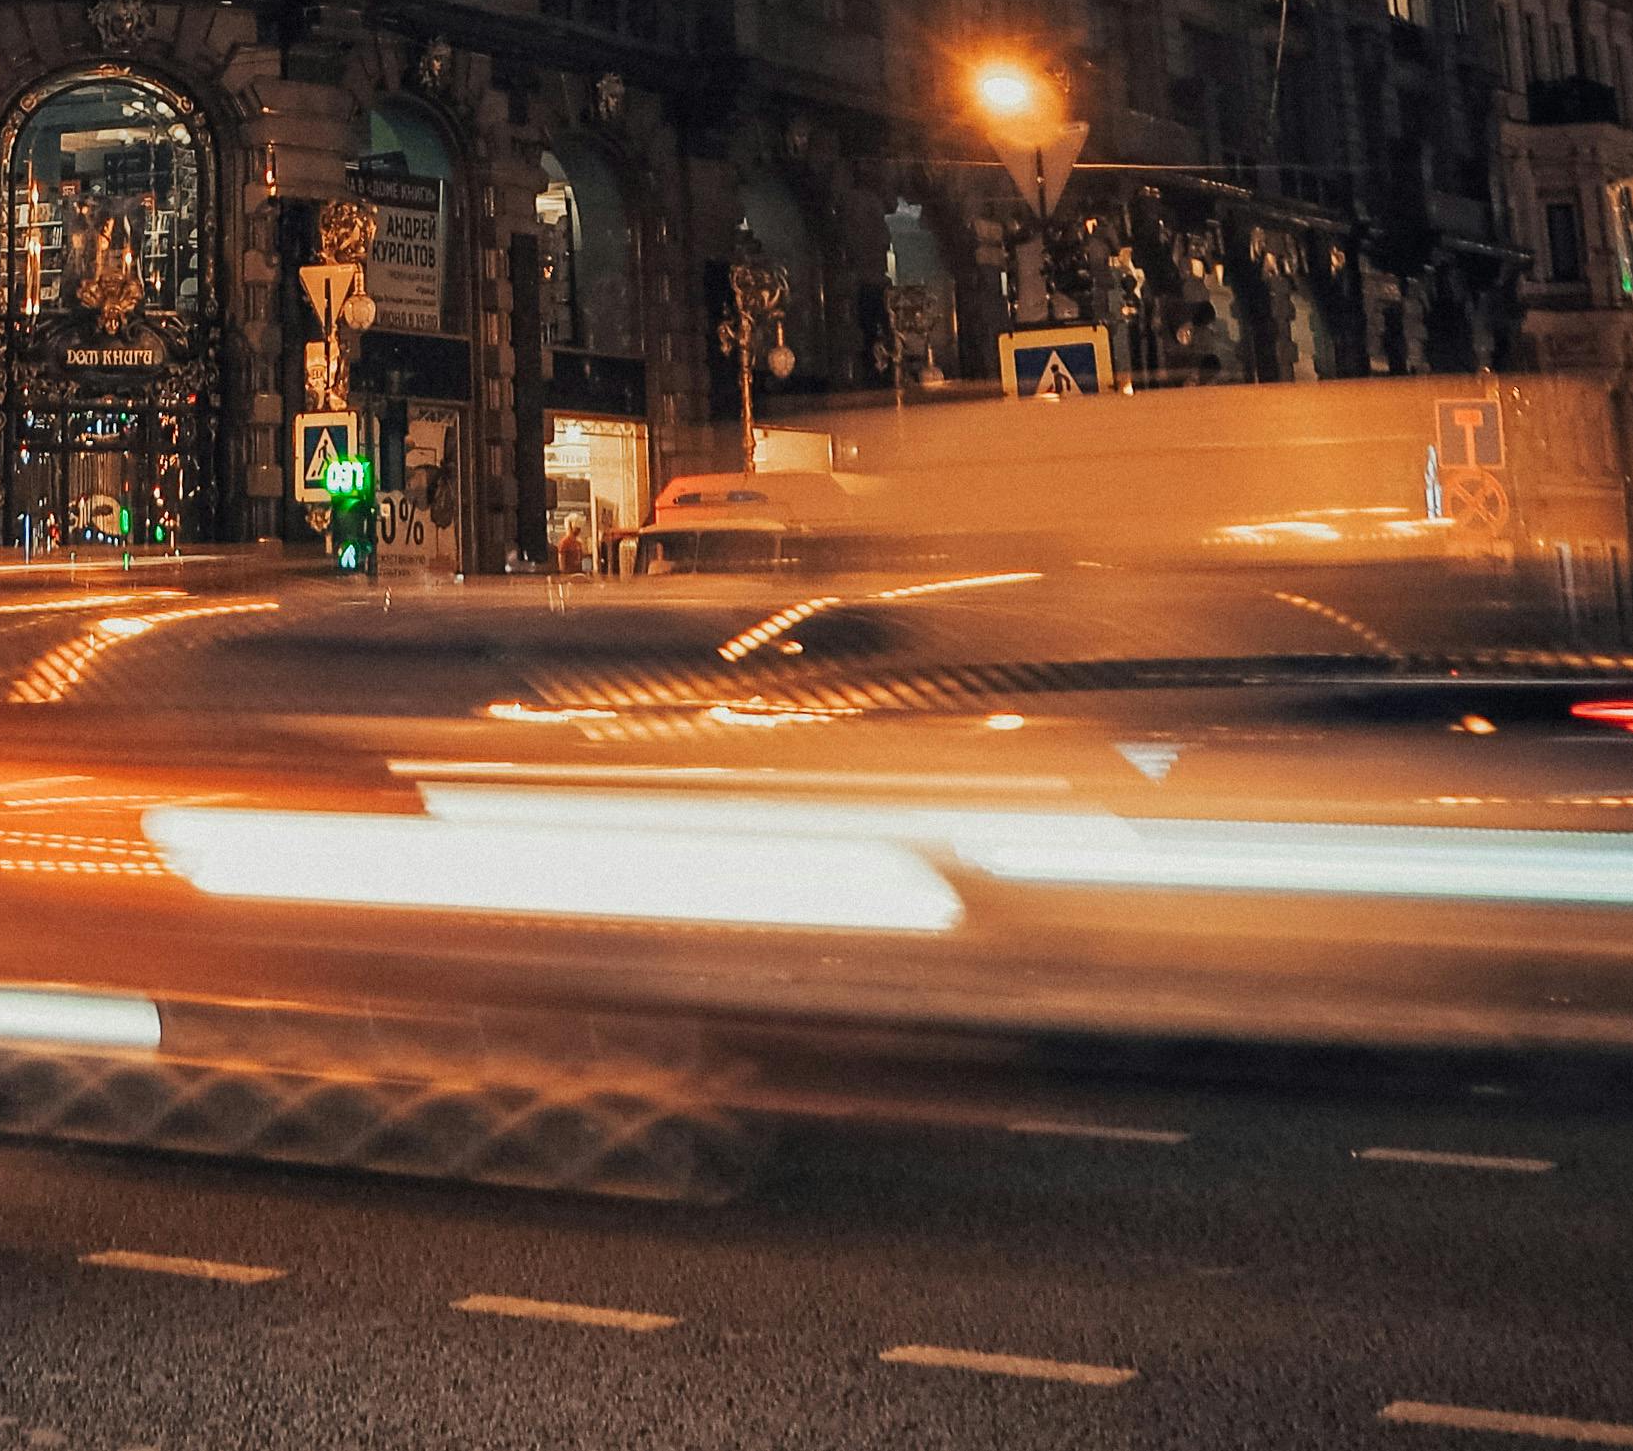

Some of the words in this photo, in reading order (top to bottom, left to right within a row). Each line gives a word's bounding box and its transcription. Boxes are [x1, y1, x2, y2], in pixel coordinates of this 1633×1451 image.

[386, 214, 436, 241] АНДРЕЙ
[372, 239, 436, 268] КУРПАТОВ
[102, 349, 153, 365] КНИГИ
